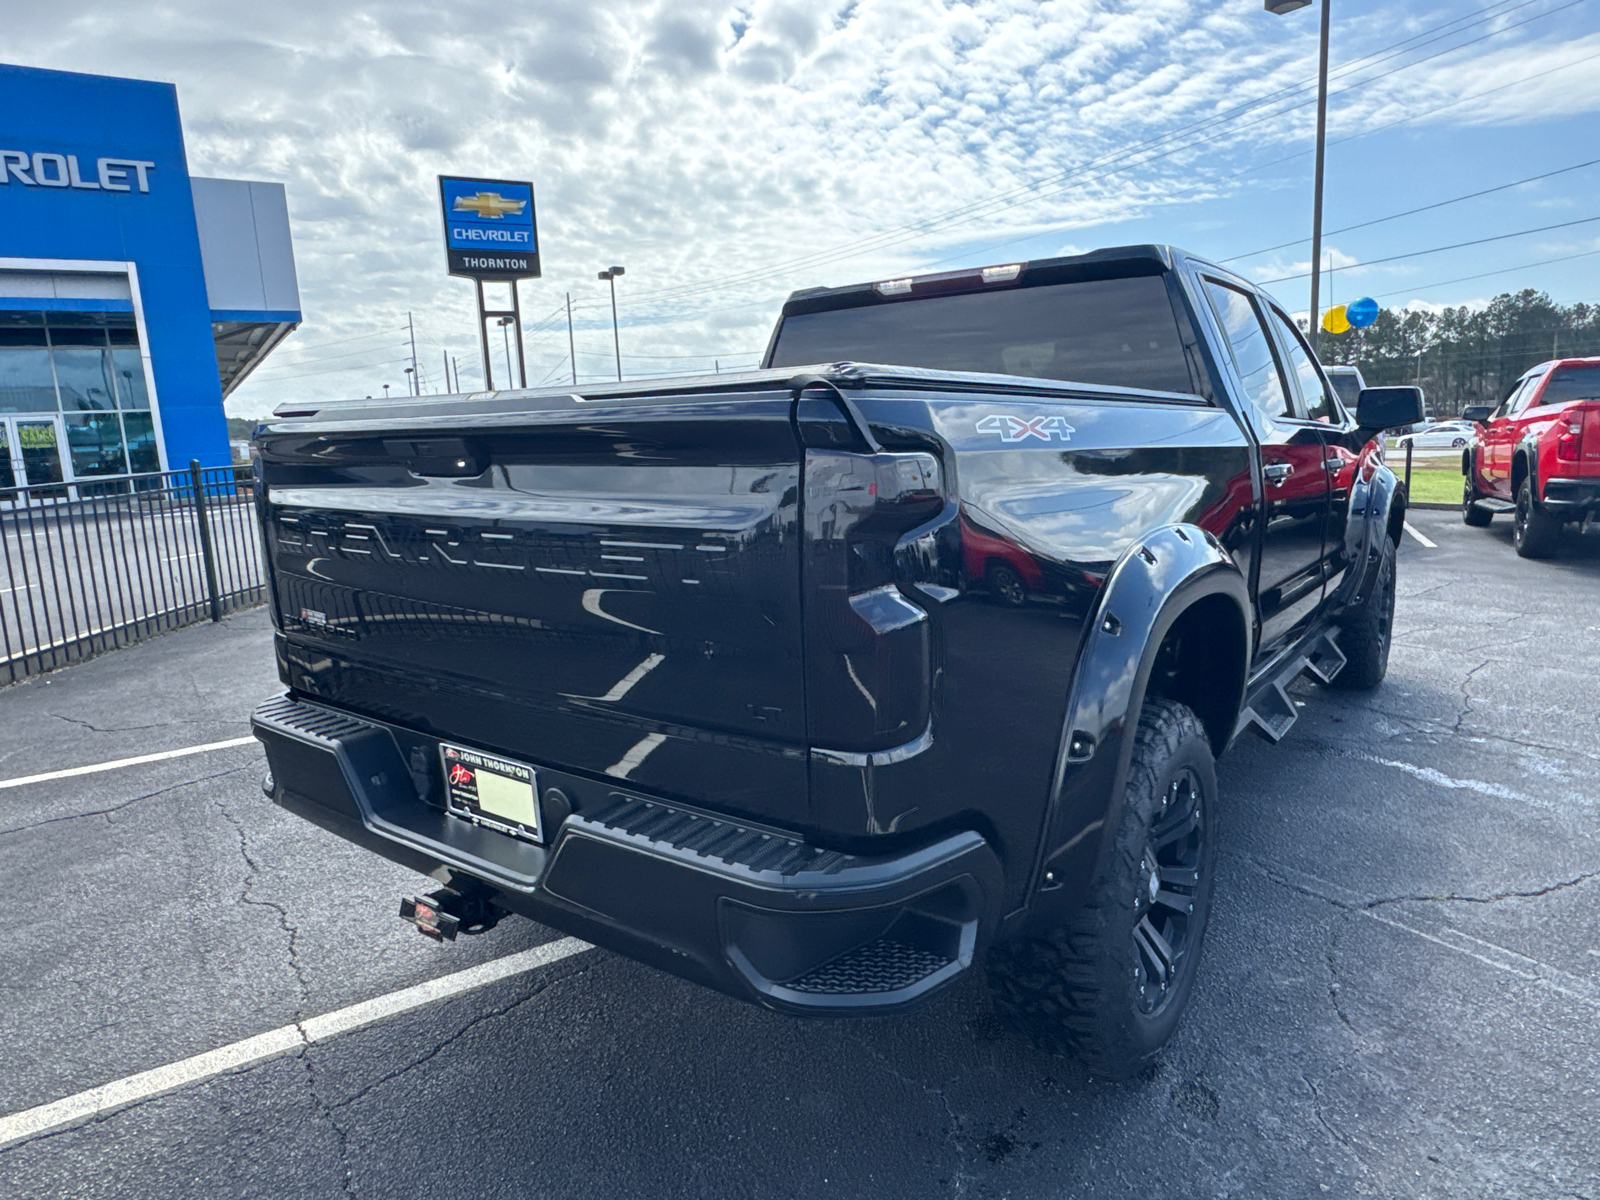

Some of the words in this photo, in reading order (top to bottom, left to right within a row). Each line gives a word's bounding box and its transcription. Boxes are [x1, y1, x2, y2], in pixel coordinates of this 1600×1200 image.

[0, 150, 155, 193] ROLET
[453, 228, 530, 242] CHEVROLET
[463, 257, 527, 269] THORNTON
[460, 751, 482, 766] JOHN
[483, 758, 529, 779] THORNTON
